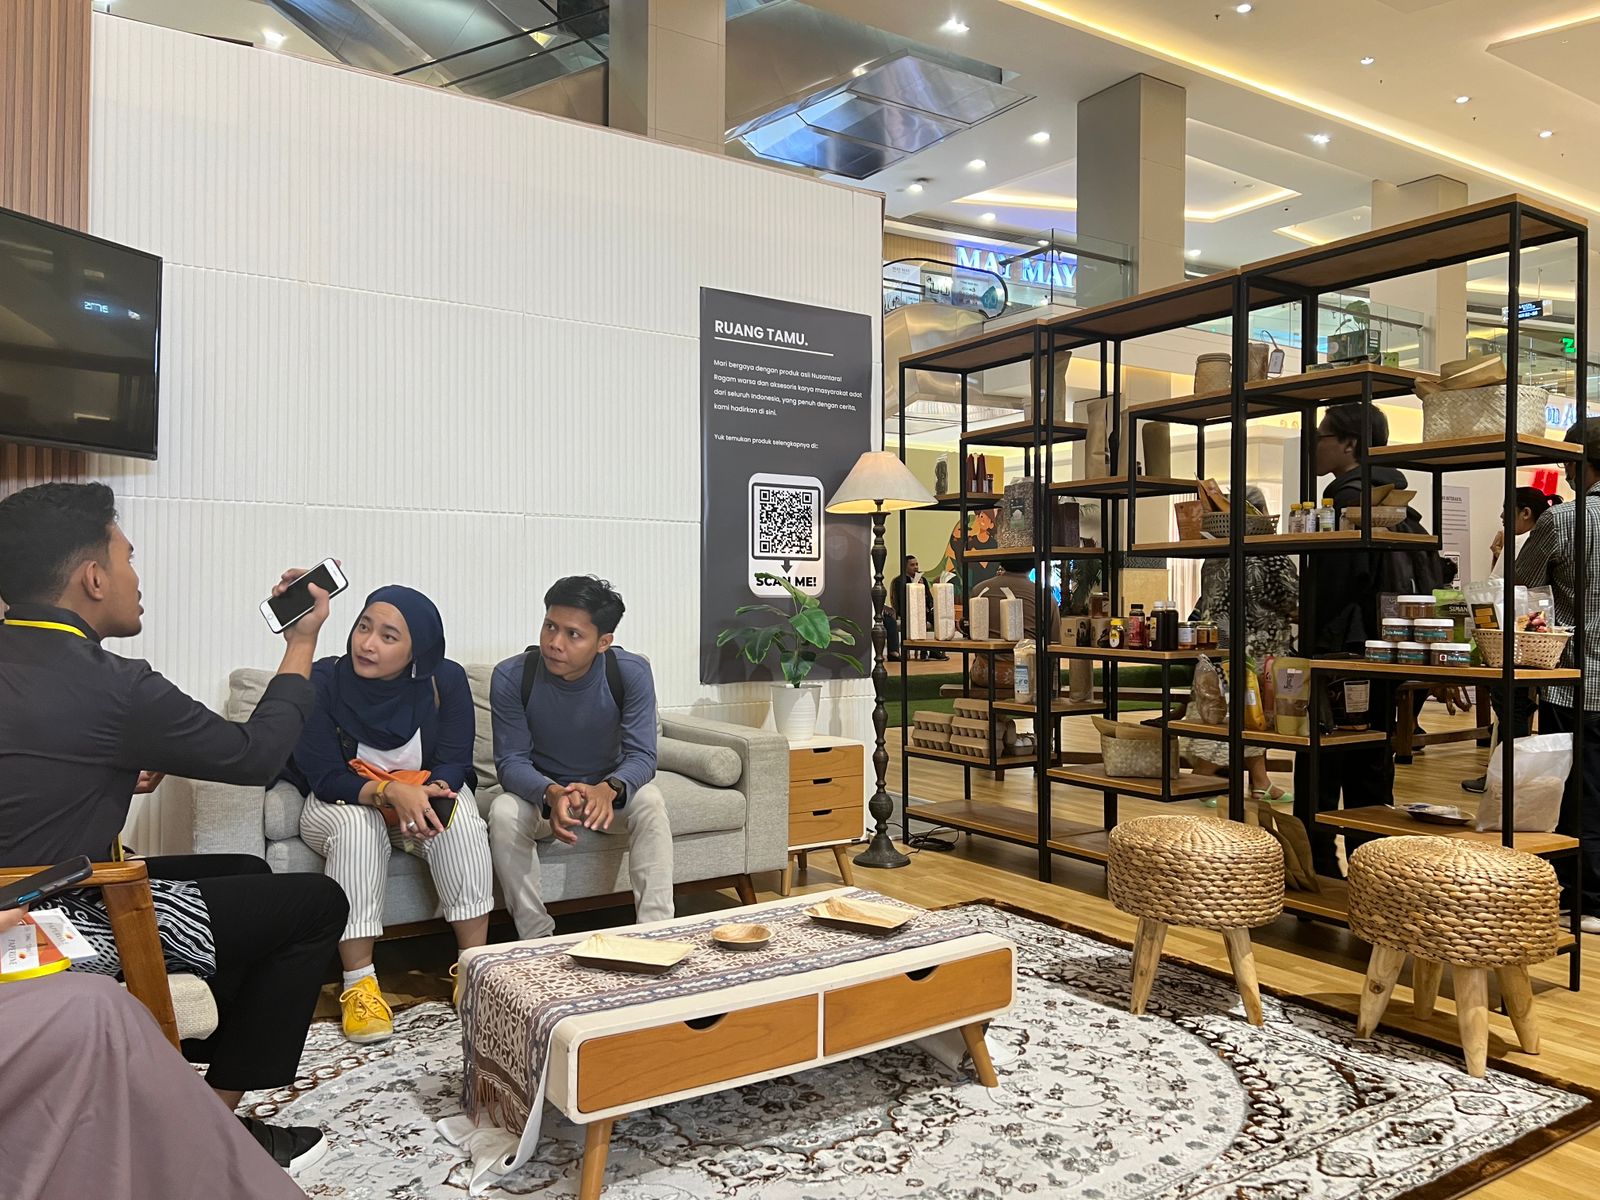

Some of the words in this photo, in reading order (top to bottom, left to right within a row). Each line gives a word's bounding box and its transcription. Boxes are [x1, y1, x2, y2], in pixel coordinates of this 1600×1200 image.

[956, 246, 1014, 279] MAY
[1020, 258, 1078, 288] MAY
[714, 319, 764, 339] RUANG
[766, 328, 809, 346] TAMU.
[713, 359, 728, 368] Mari
[728, 361, 755, 372] bergaya
[755, 365, 778, 374] dengan
[779, 368, 800, 376] produk
[713, 374, 736, 383] Ragam
[770, 381, 796, 390] aksesoris
[798, 384, 814, 394] karya
[815, 387, 848, 396] masyarakat
[713, 402, 730, 410] kami
[730, 405, 758, 414] hadirkan
[727, 390, 750, 399] seluruh
[750, 394, 780, 402] Indonesia,
[782, 398, 796, 406] yang
[816, 402, 838, 410] dengan
[725, 435, 752, 443] temukan
[772, 440, 810, 450] selengkapnya
[795, 576, 817, 587] ME!
